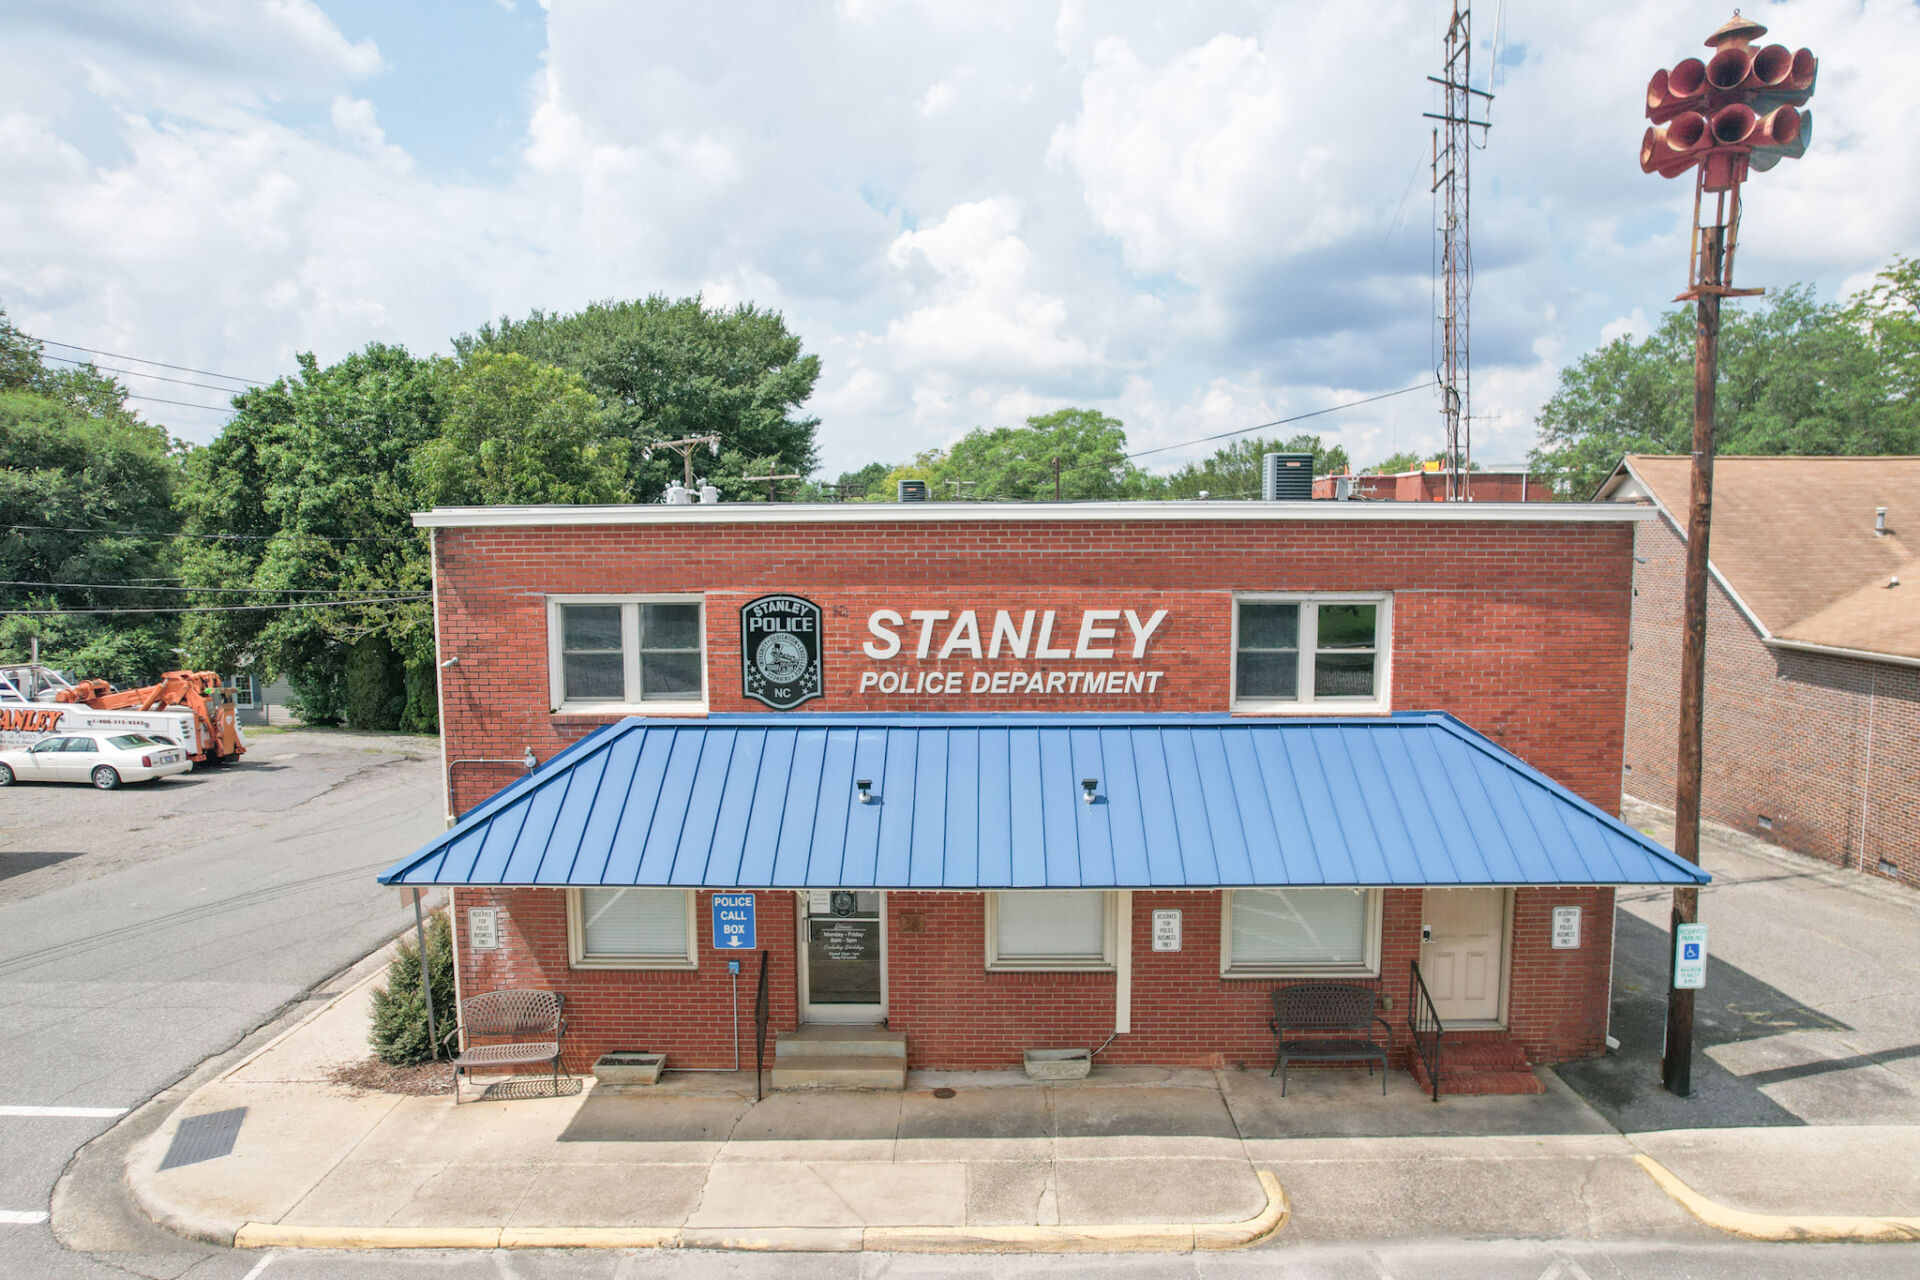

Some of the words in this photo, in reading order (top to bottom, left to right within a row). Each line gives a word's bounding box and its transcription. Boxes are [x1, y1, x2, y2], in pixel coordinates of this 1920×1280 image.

[753, 600, 809, 617] STANLEY
[749, 617, 813, 632] POLICE
[863, 609, 1169, 660] STANLEY
[859, 671, 964, 694] POLICE
[970, 671, 1164, 694] DEPARTMENT
[774, 688, 791, 698] NC
[0, 709, 64, 731] ANLEY
[714, 897, 752, 907] POLICE
[720, 911, 747, 920] CALL
[723, 925, 745, 934] BOX
